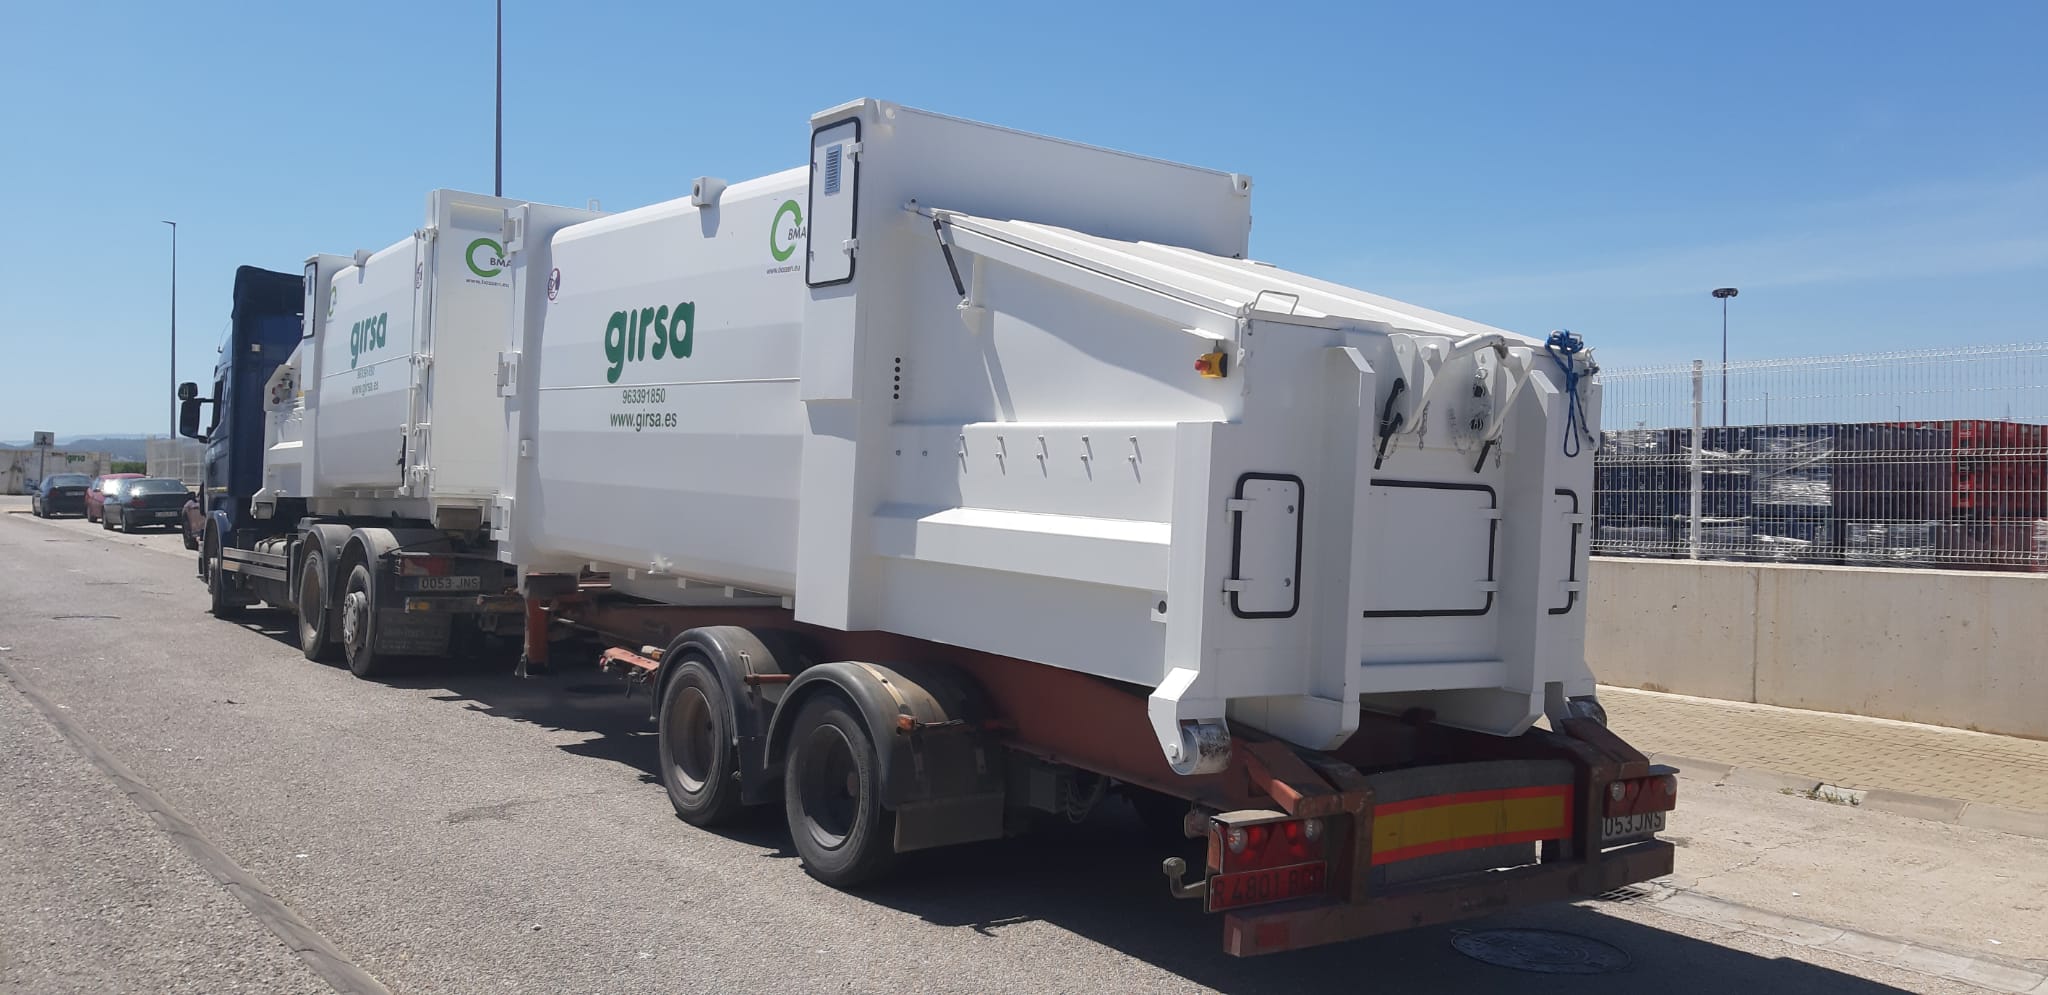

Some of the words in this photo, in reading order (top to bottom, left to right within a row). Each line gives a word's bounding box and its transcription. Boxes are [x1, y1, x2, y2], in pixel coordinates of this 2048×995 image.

[789, 226, 807, 241] BMA
[350, 312, 388, 369] girsa
[605, 301, 696, 384] girsa
[622, 388, 666, 405] 963391850
[610, 409, 678, 432] www.girsa.es
[422, 577, 452, 589] 0053
[456, 576, 480, 588] JNS
